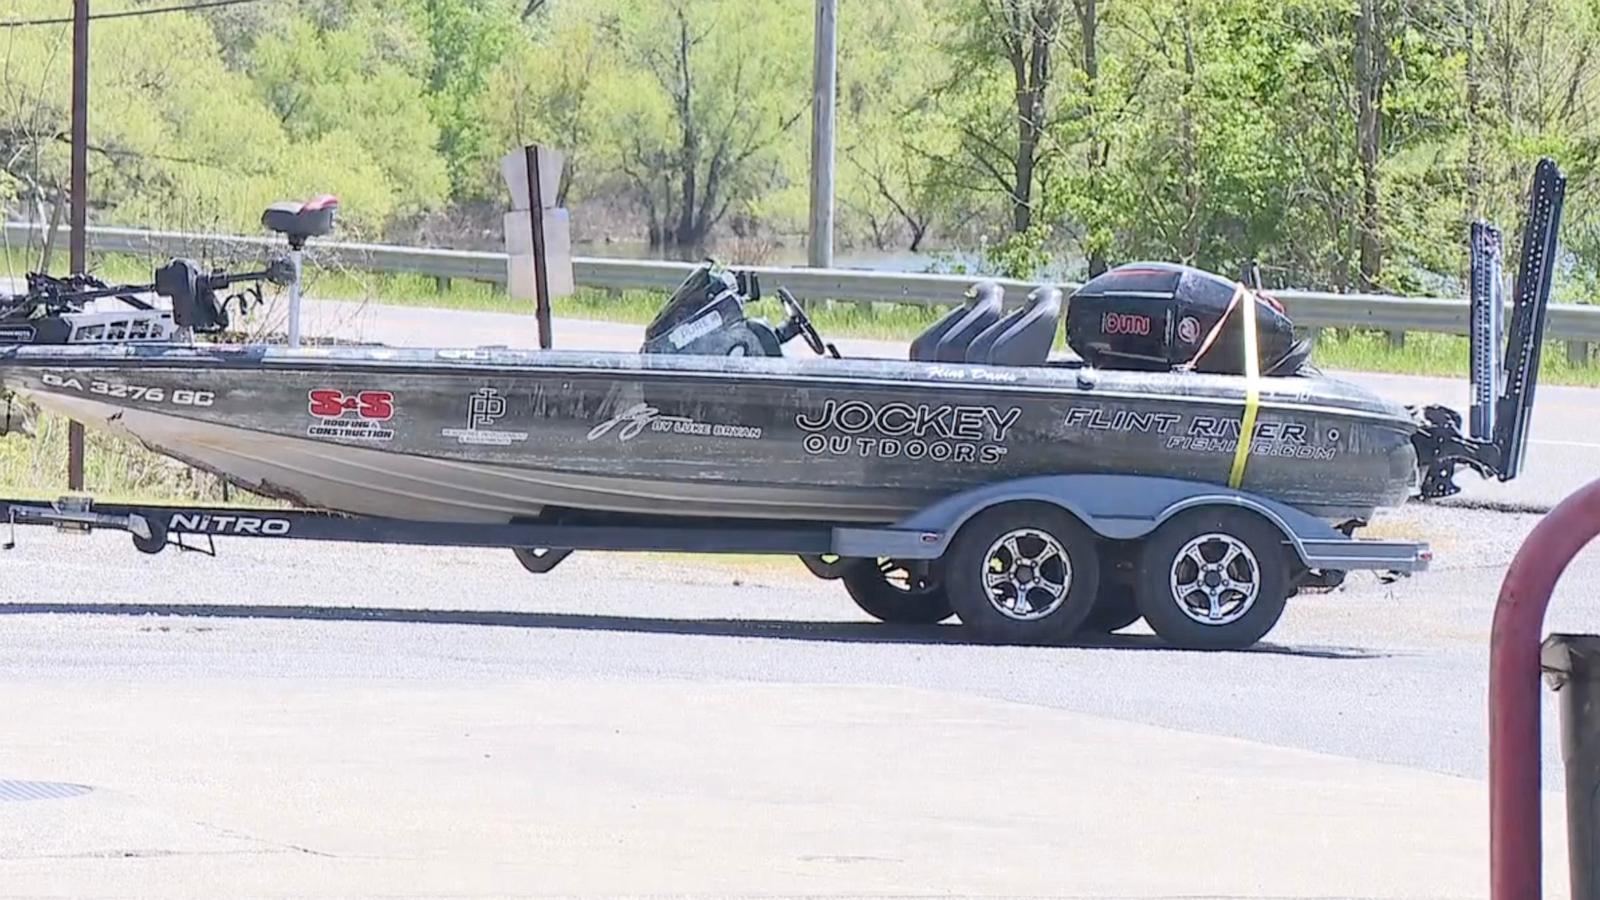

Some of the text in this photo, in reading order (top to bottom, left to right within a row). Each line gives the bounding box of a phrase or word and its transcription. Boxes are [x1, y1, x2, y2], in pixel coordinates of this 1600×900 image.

[42, 374, 215, 406] GA 3276 GC
[309, 427, 392, 438] CONSTRUCTION
[323, 419, 369, 428] ROOFING
[675, 422, 711, 435] LUKE
[713, 425, 762, 439] BRYAN
[796, 400, 1022, 441] JOCKEY
[1064, 408, 1181, 434] FLINT
[803, 434, 1001, 463] OUTDOORS
[1166, 435, 1337, 461] FISHIG.COM
